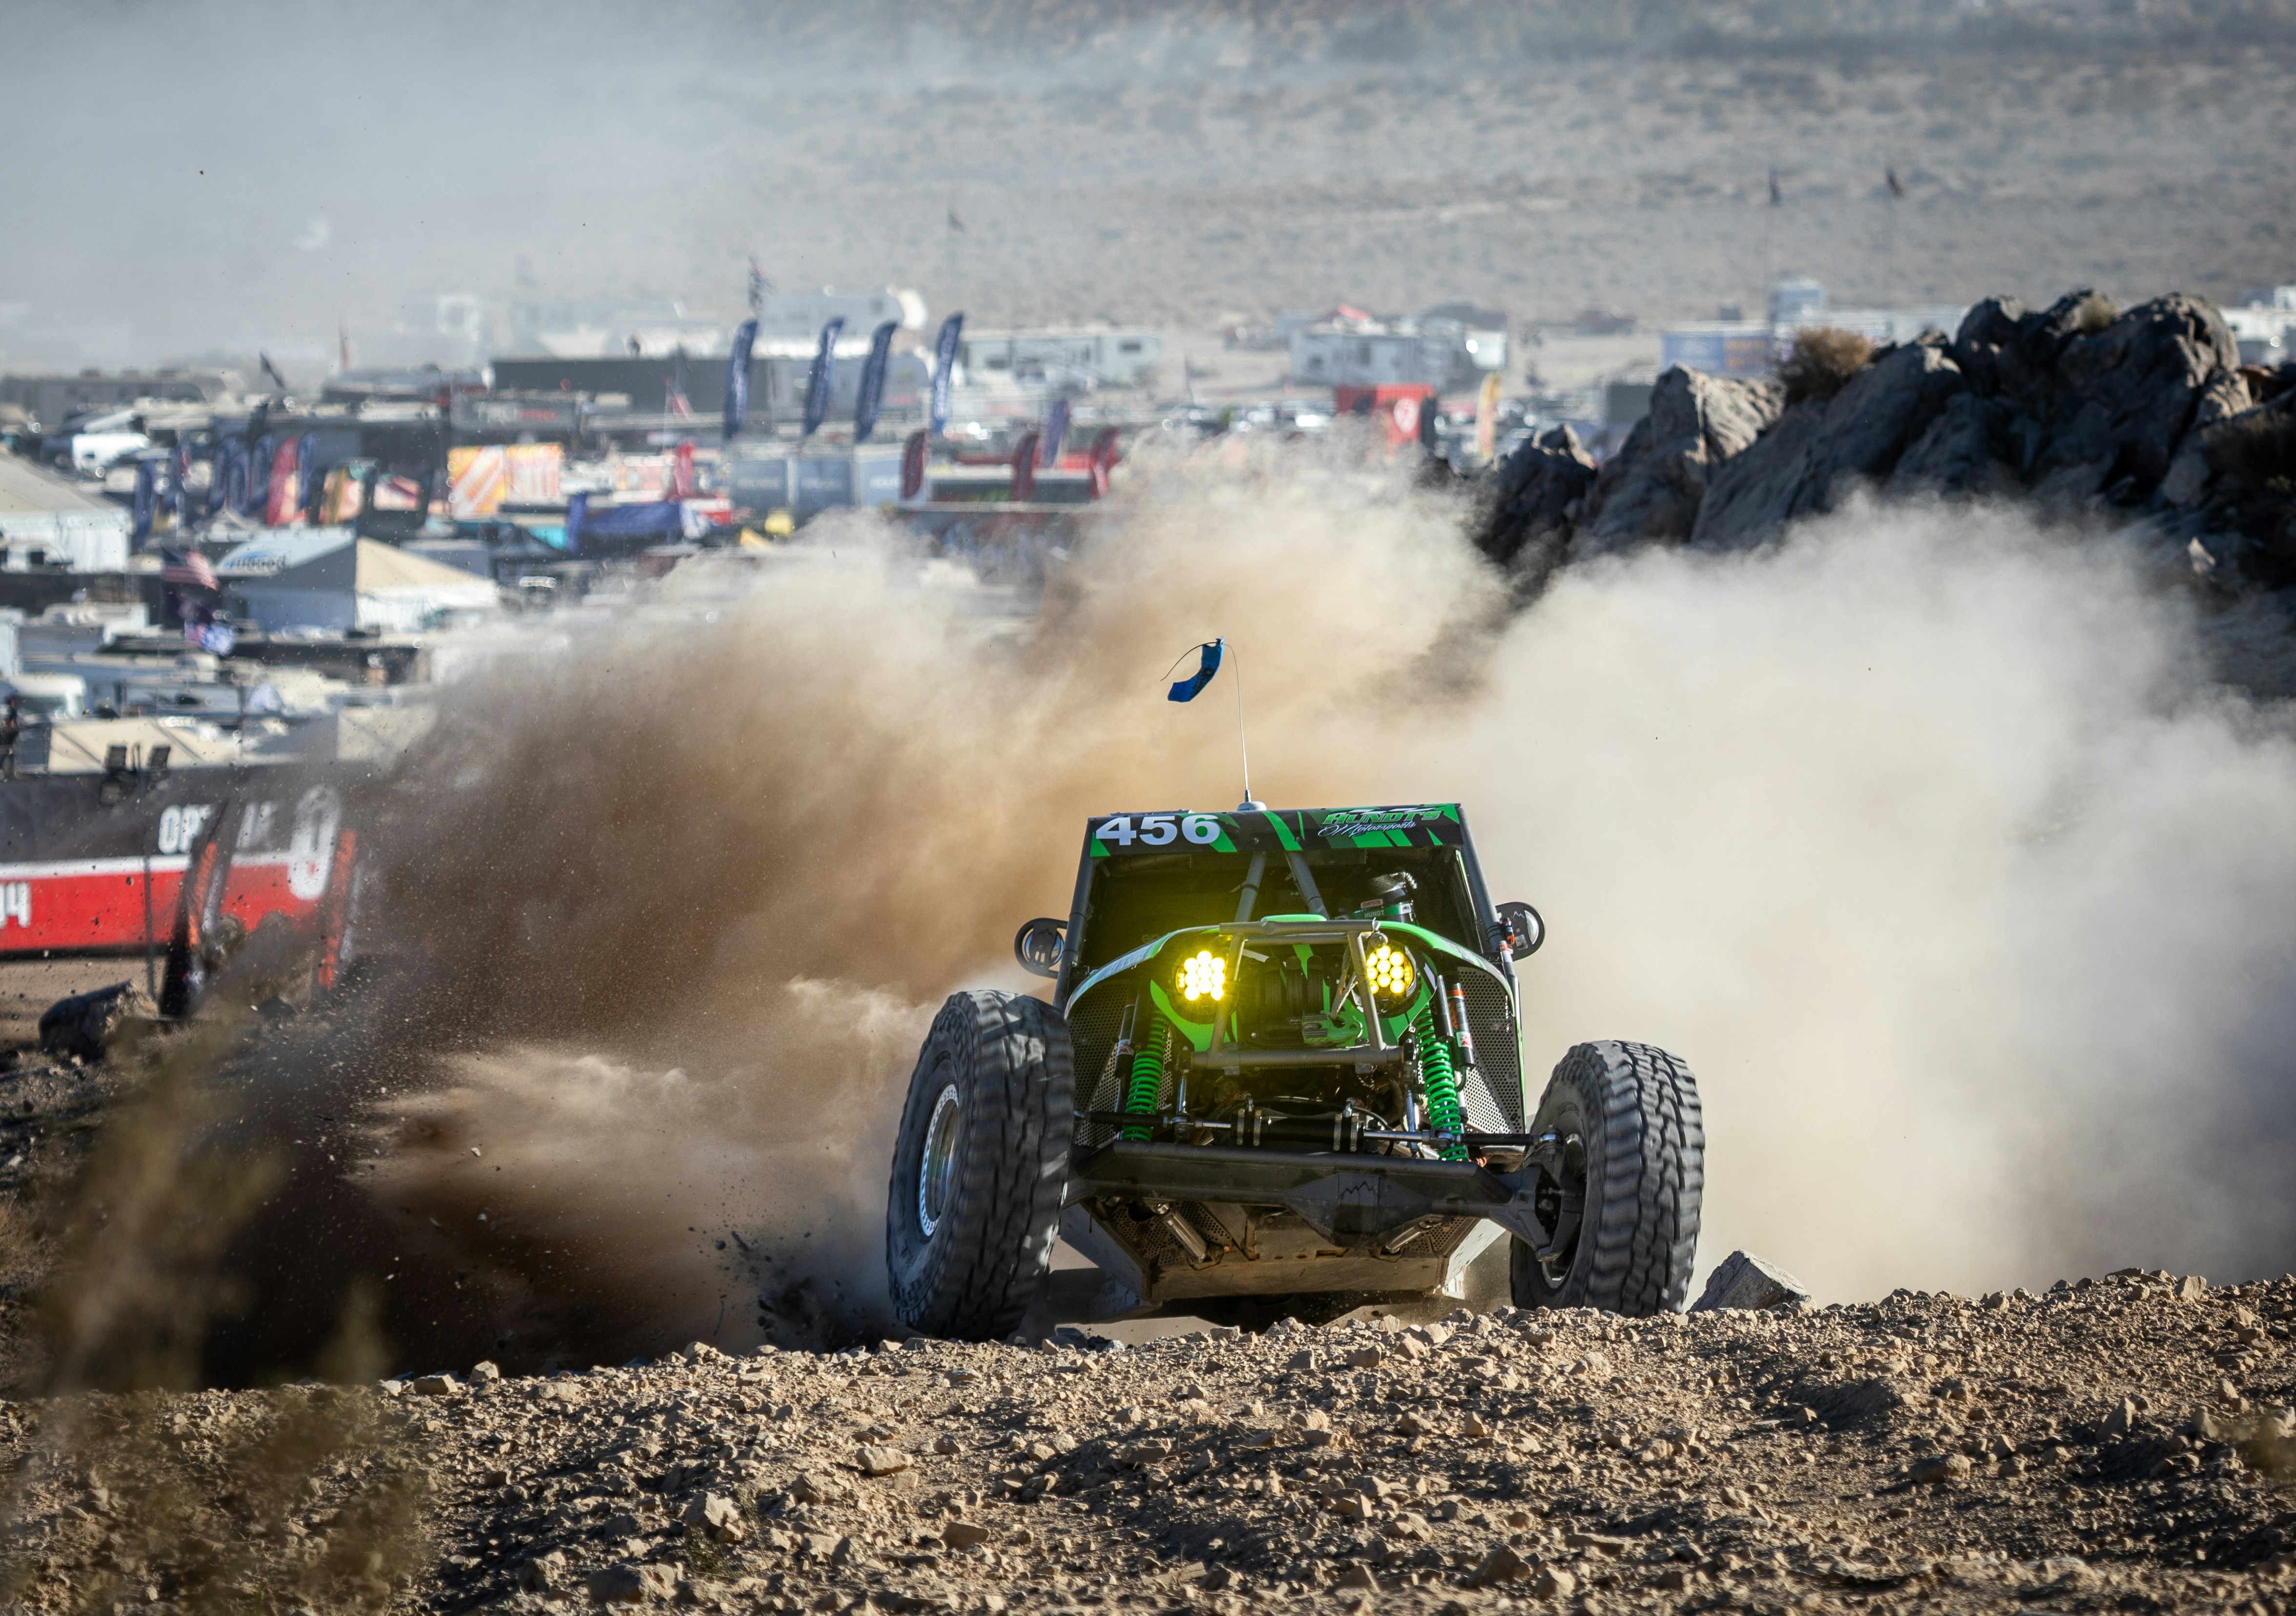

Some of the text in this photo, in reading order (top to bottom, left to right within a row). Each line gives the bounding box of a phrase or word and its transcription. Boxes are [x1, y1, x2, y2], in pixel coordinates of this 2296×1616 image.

[1096, 814, 1220, 846] 456
[1318, 821, 1416, 838] Motorsports
[1364, 909, 1384, 919] HUNDT
